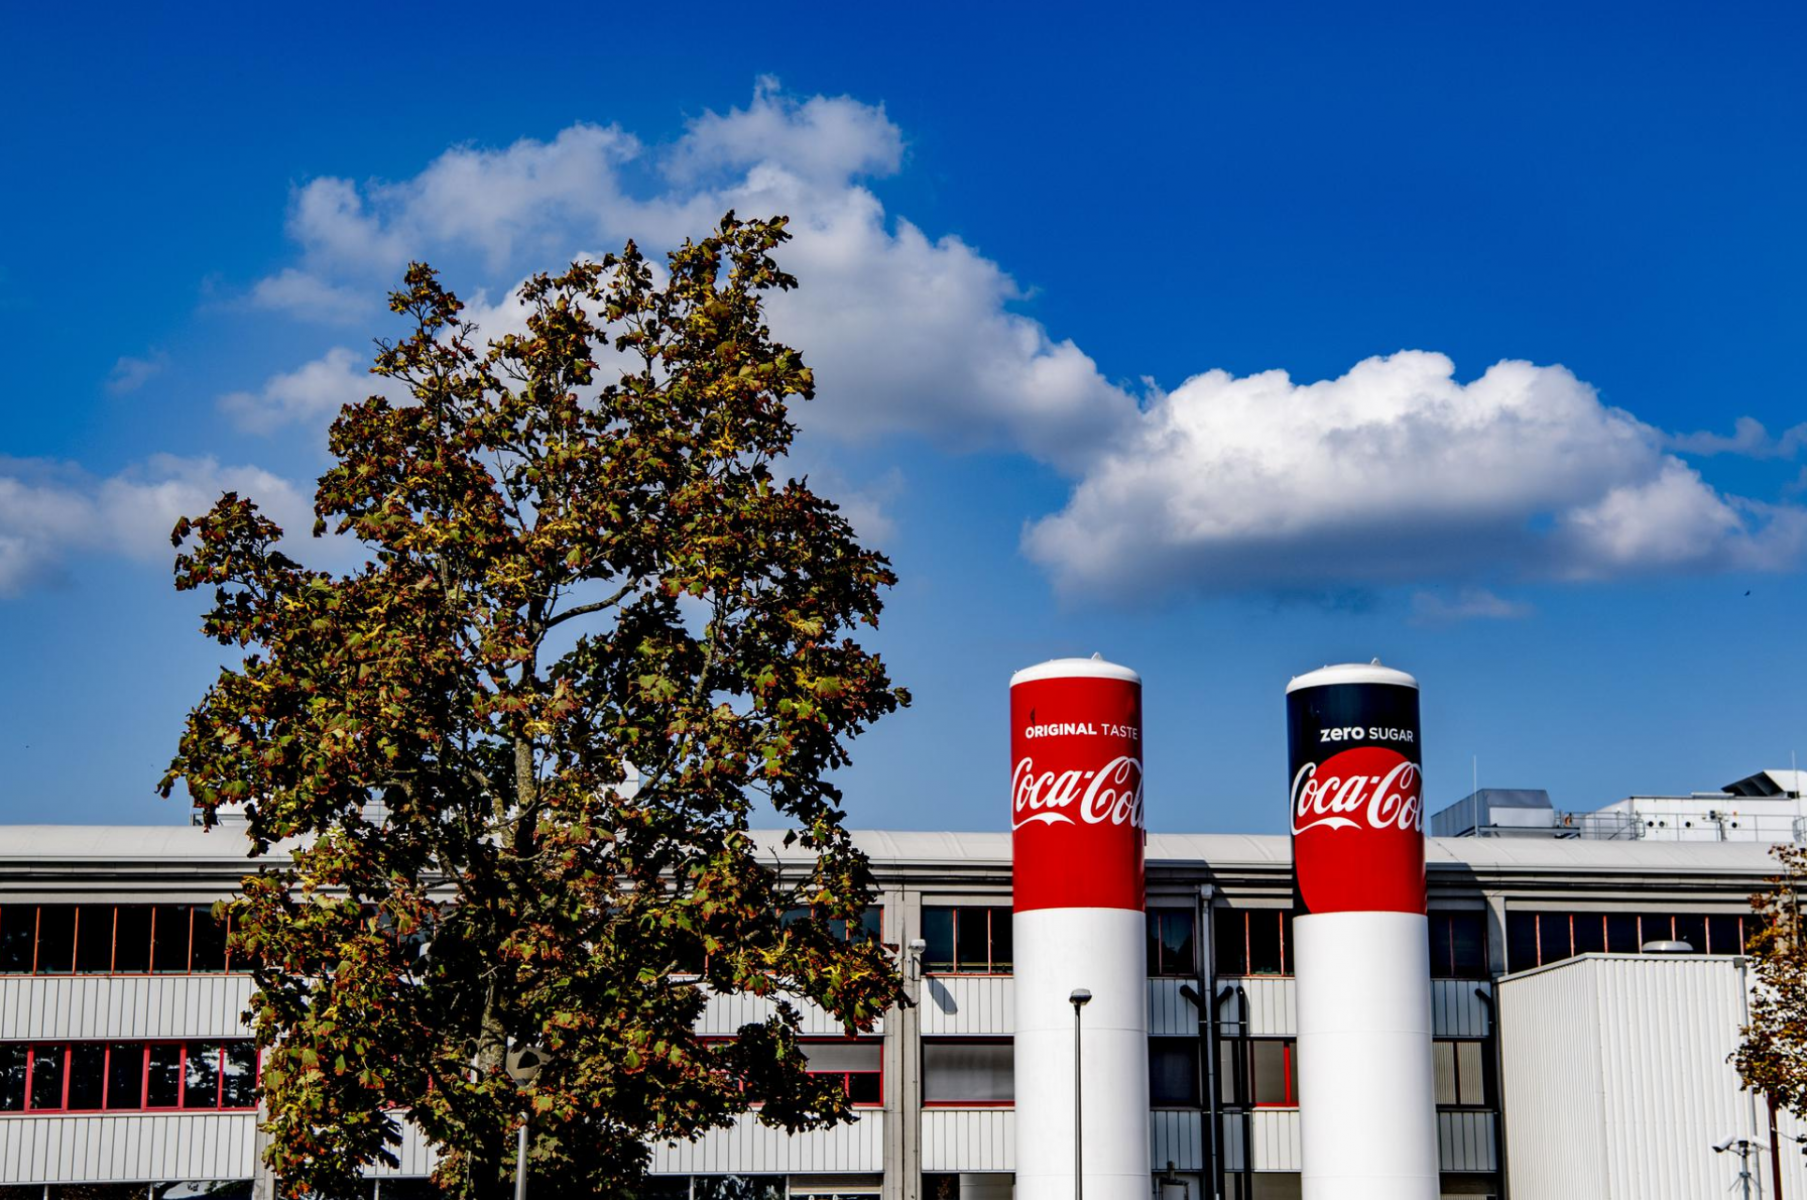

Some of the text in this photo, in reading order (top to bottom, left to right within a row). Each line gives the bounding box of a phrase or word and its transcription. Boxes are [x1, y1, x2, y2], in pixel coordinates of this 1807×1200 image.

[1025, 722, 1138, 740] ORIGINAL TASTE
[1320, 726, 1414, 743] zero SUGAR
[1011, 755, 1144, 831] Coca-Col
[1290, 761, 1424, 836] Coca-Col
